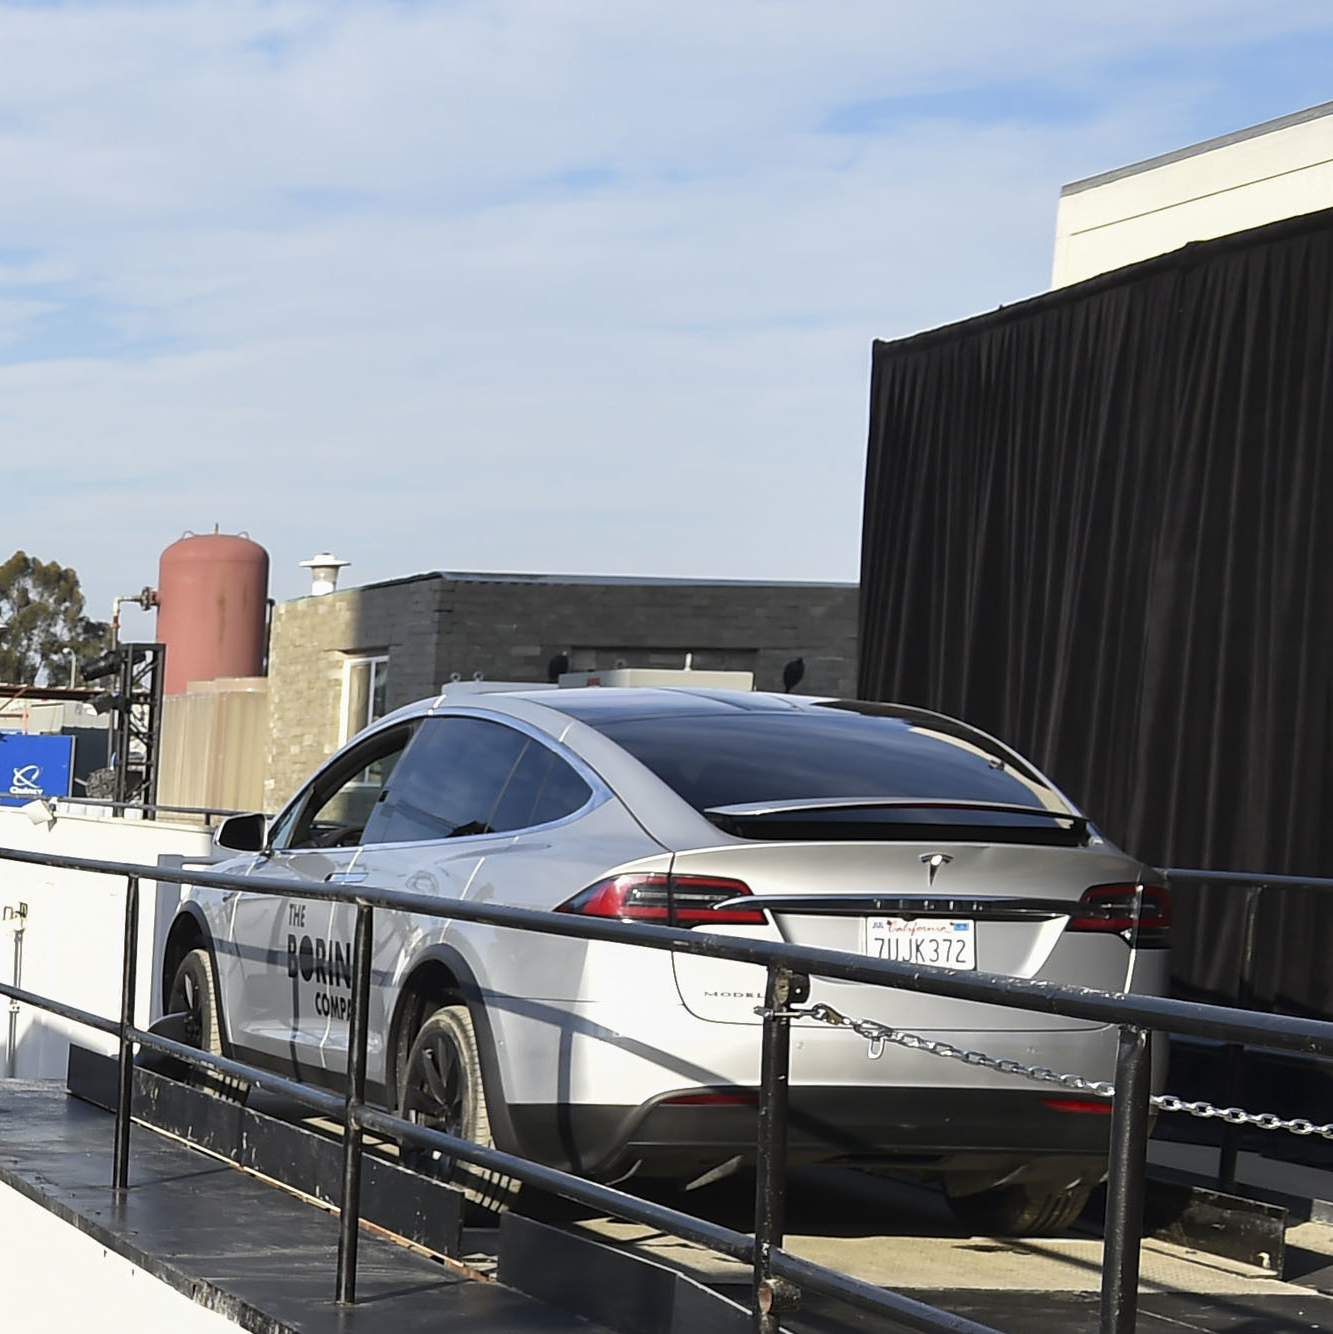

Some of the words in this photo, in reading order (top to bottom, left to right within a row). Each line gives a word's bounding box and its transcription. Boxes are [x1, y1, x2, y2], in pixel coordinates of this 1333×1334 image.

[288, 903, 306, 928] THE
[888, 920, 952, 935] California
[287, 933, 351, 989] BORIN
[874, 937, 967, 963] 7UJK372
[314, 991, 351, 1021] COMP
